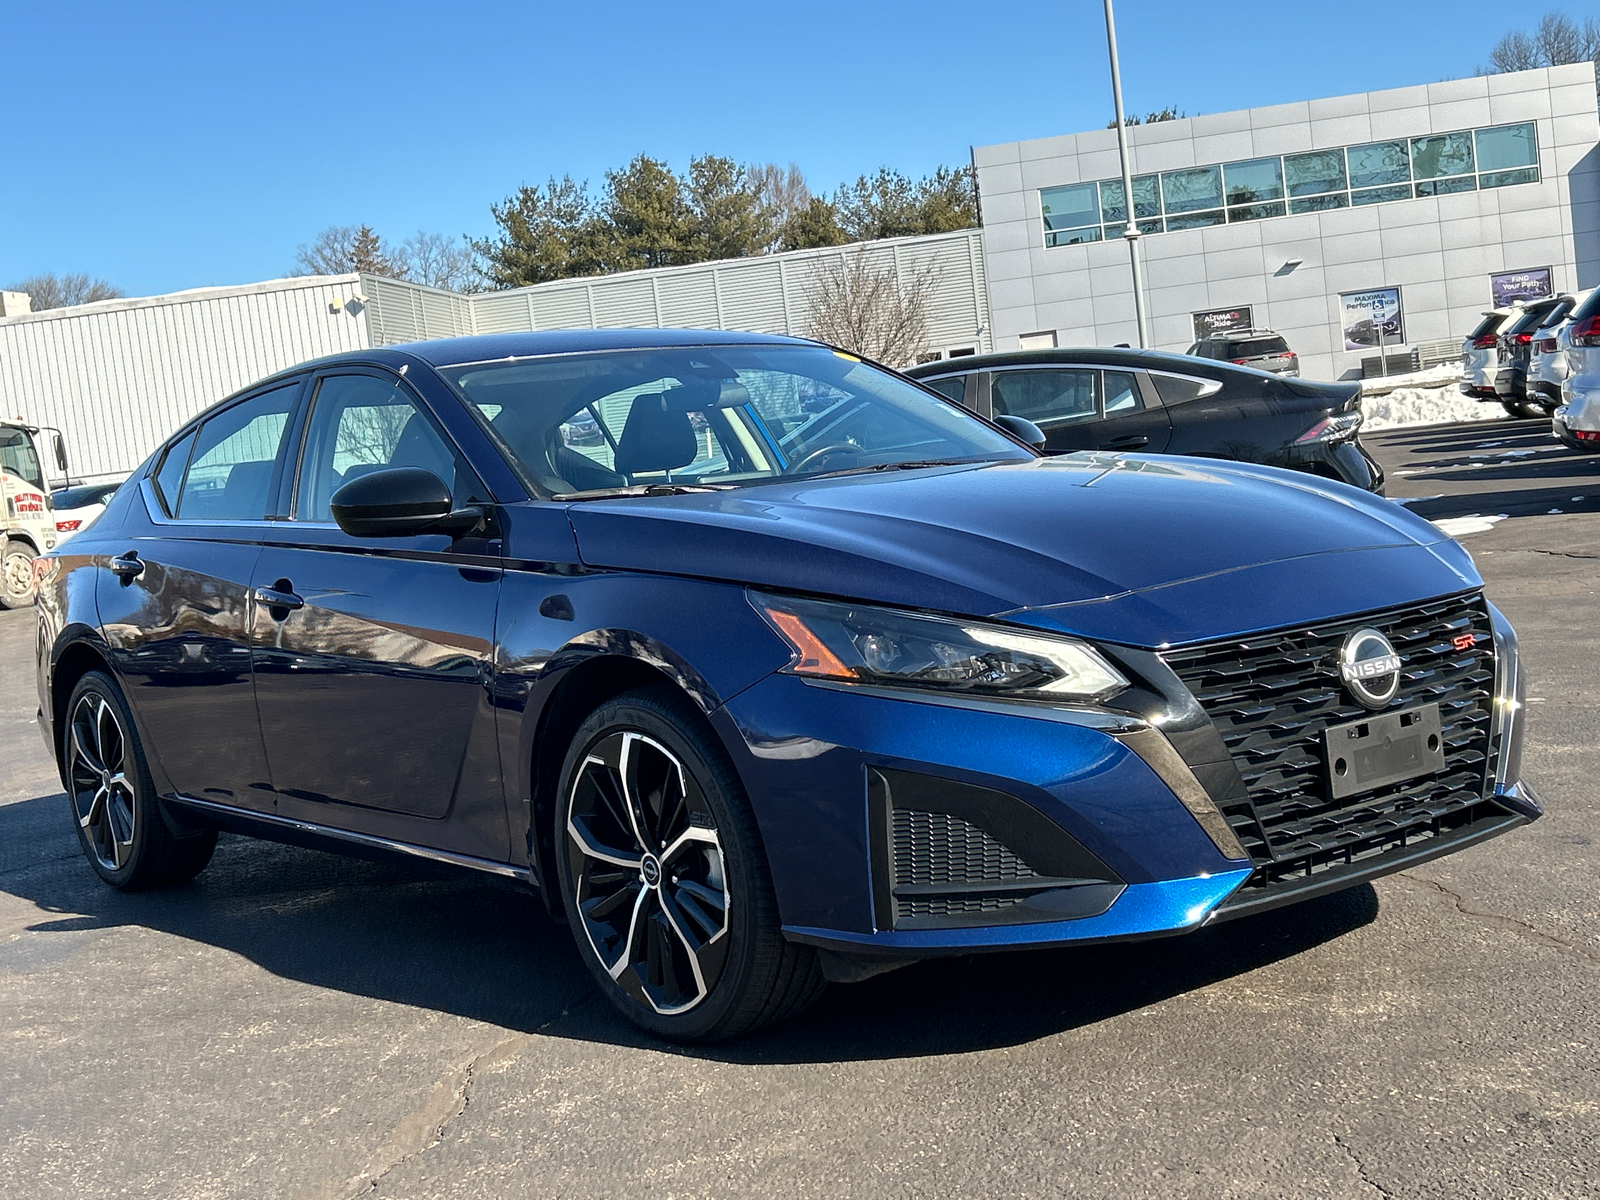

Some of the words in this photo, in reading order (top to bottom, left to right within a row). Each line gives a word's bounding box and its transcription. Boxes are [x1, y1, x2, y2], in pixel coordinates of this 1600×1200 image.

[1521, 280, 1540, 288] Path
[1354, 294, 1386, 303] MAXIMA
[1346, 299, 1395, 310] Perforce
[1453, 633, 1475, 650] SR
[1344, 656, 1401, 679] NISSAN
